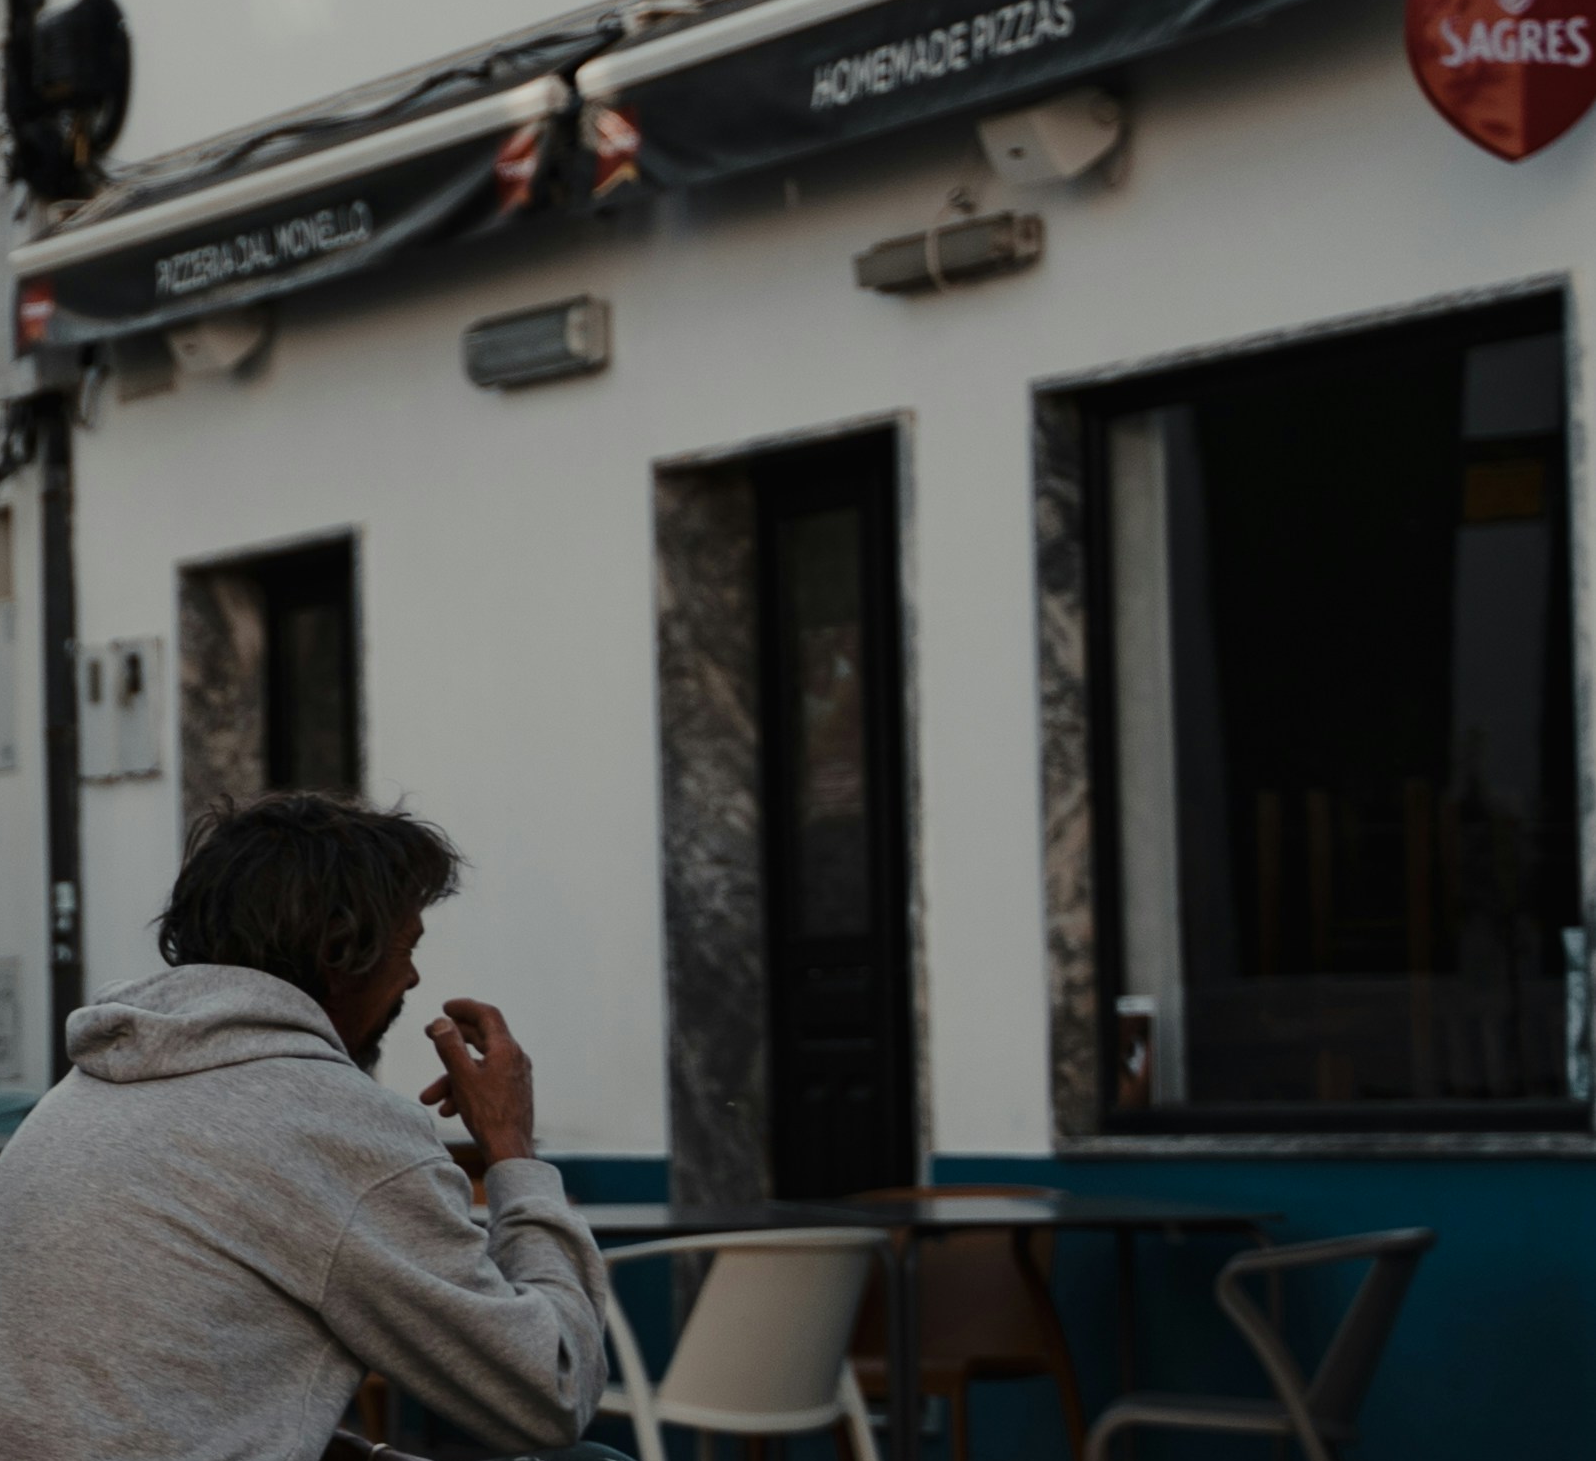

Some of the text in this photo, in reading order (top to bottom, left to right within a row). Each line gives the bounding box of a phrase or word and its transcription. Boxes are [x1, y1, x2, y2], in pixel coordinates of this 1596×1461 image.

[810, 19, 971, 112] HOMEMADE
[1439, 15, 1592, 69] SAGRES
[154, 240, 236, 299] PIZZERIA
